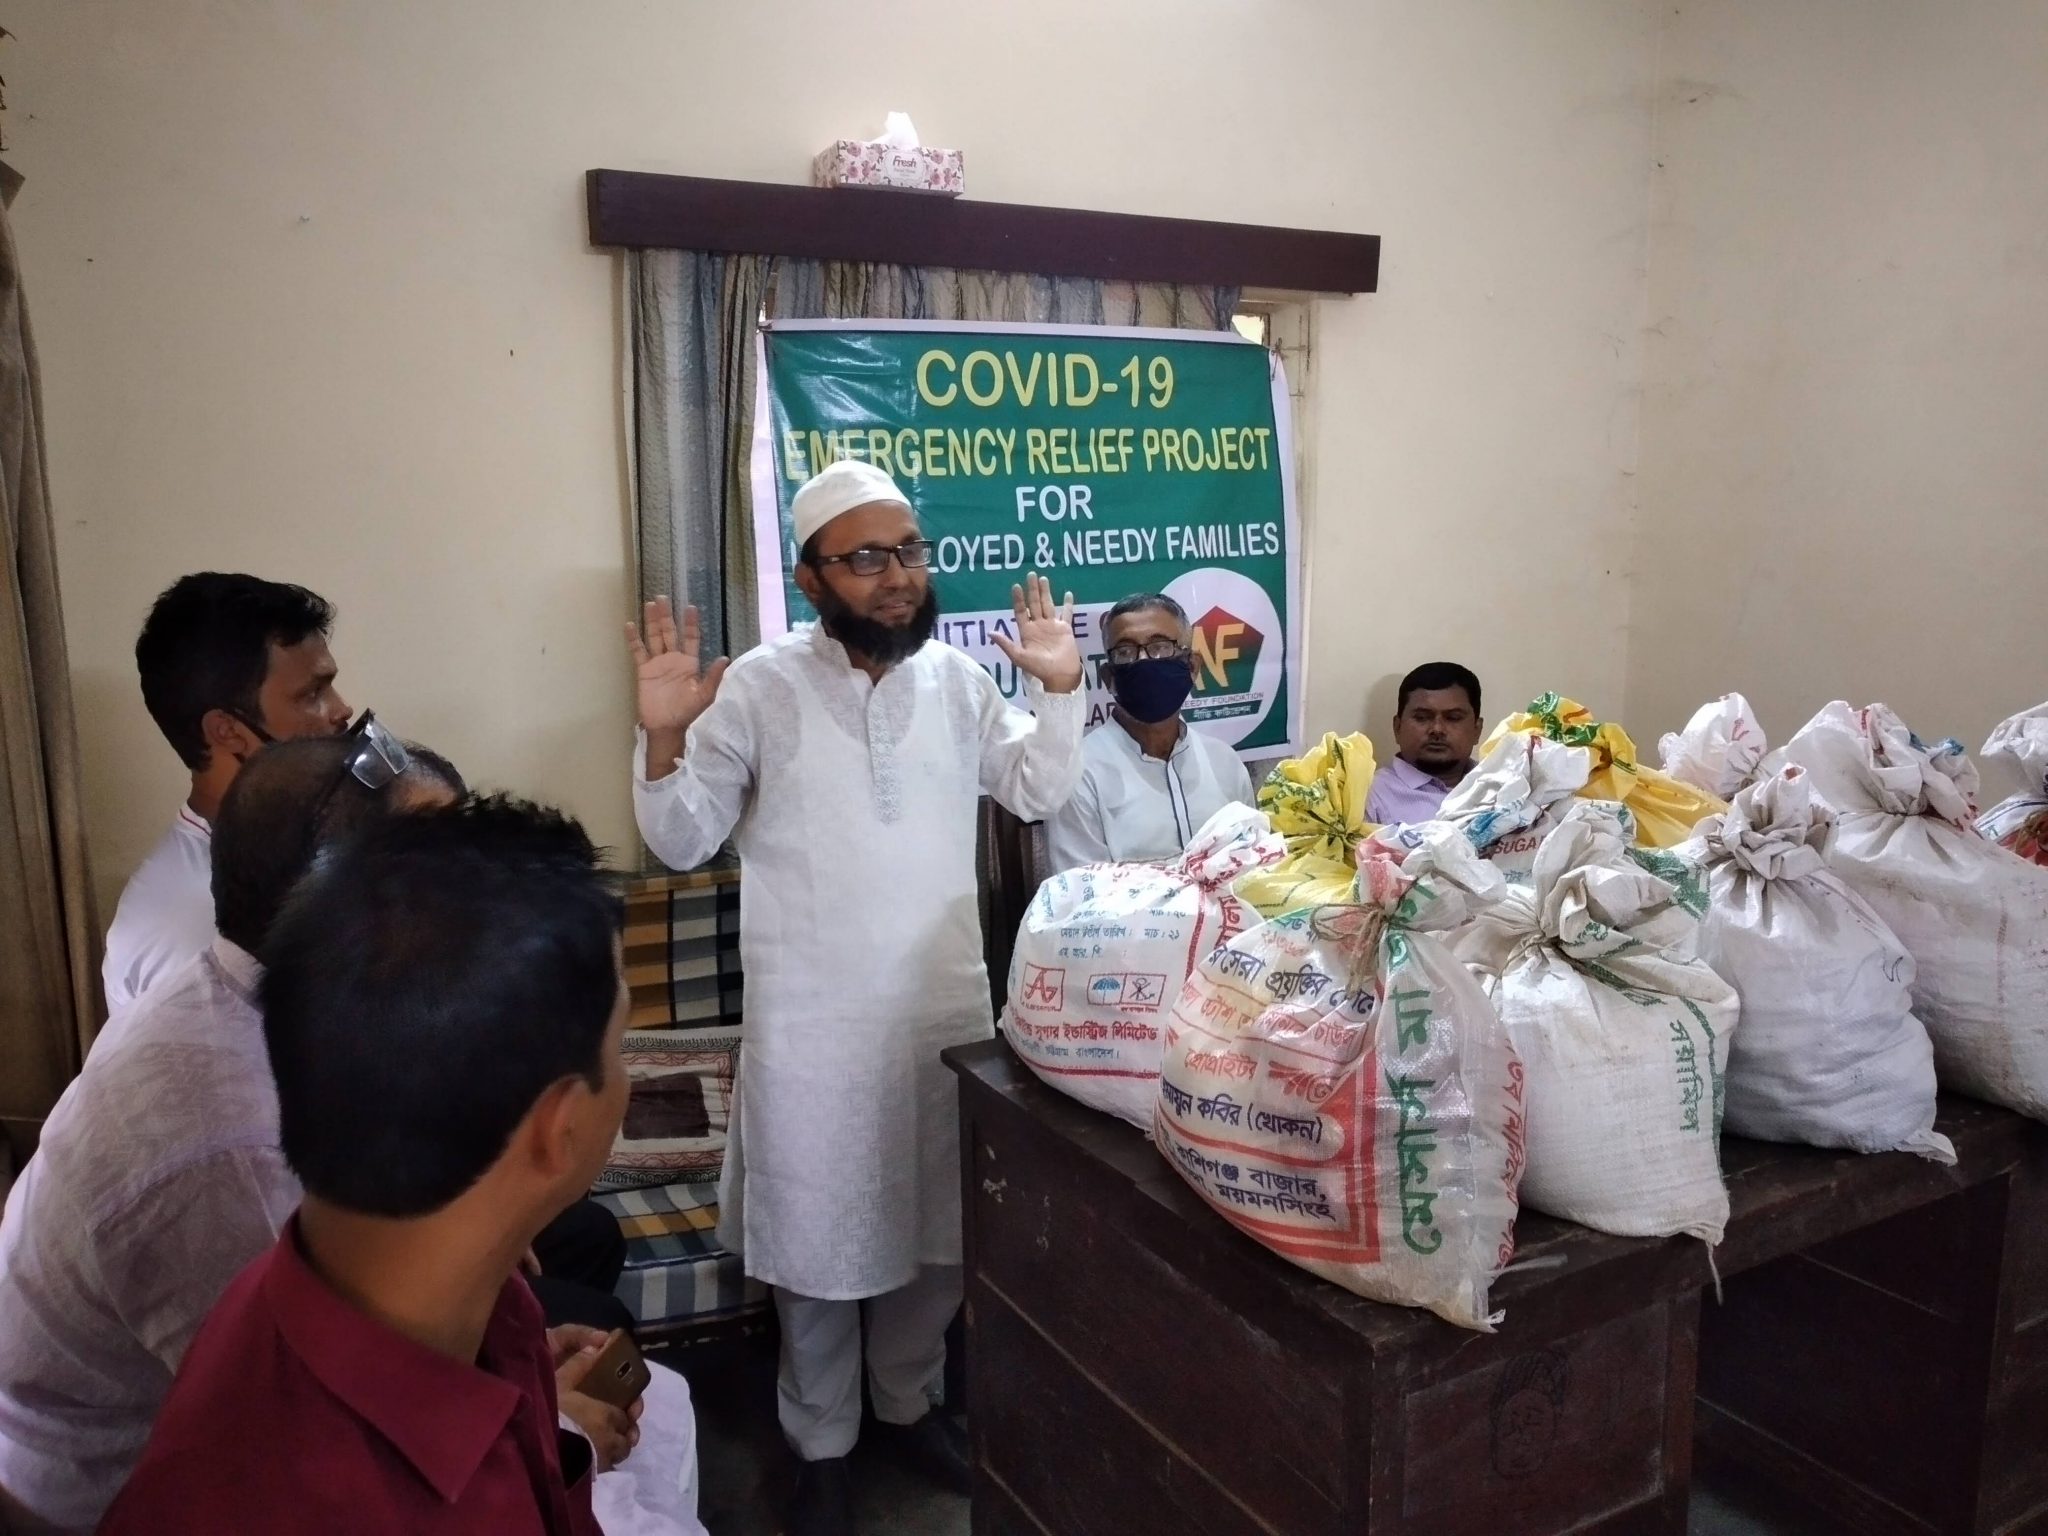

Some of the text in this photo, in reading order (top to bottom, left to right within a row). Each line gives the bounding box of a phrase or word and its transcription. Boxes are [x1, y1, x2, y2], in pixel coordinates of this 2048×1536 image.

[892, 155, 917, 168] Fresh
[916, 349, 1174, 409] COVID-19
[783, 427, 1271, 481] EMERGENCY RELIEF PROJECT
[1015, 484, 1094, 523] FOR
[1034, 531, 1056, 569] &
[1063, 527, 1158, 567] NEEDY
[1165, 522, 1280, 561] FAMILIES
[1211, 691, 1265, 705] FOUNDATION
[1197, 1093, 1242, 1127] কবির
[1247, 1102, 1323, 1145] (খোকন)
[1214, 1182, 1337, 1223] ময়মনসিংহ
